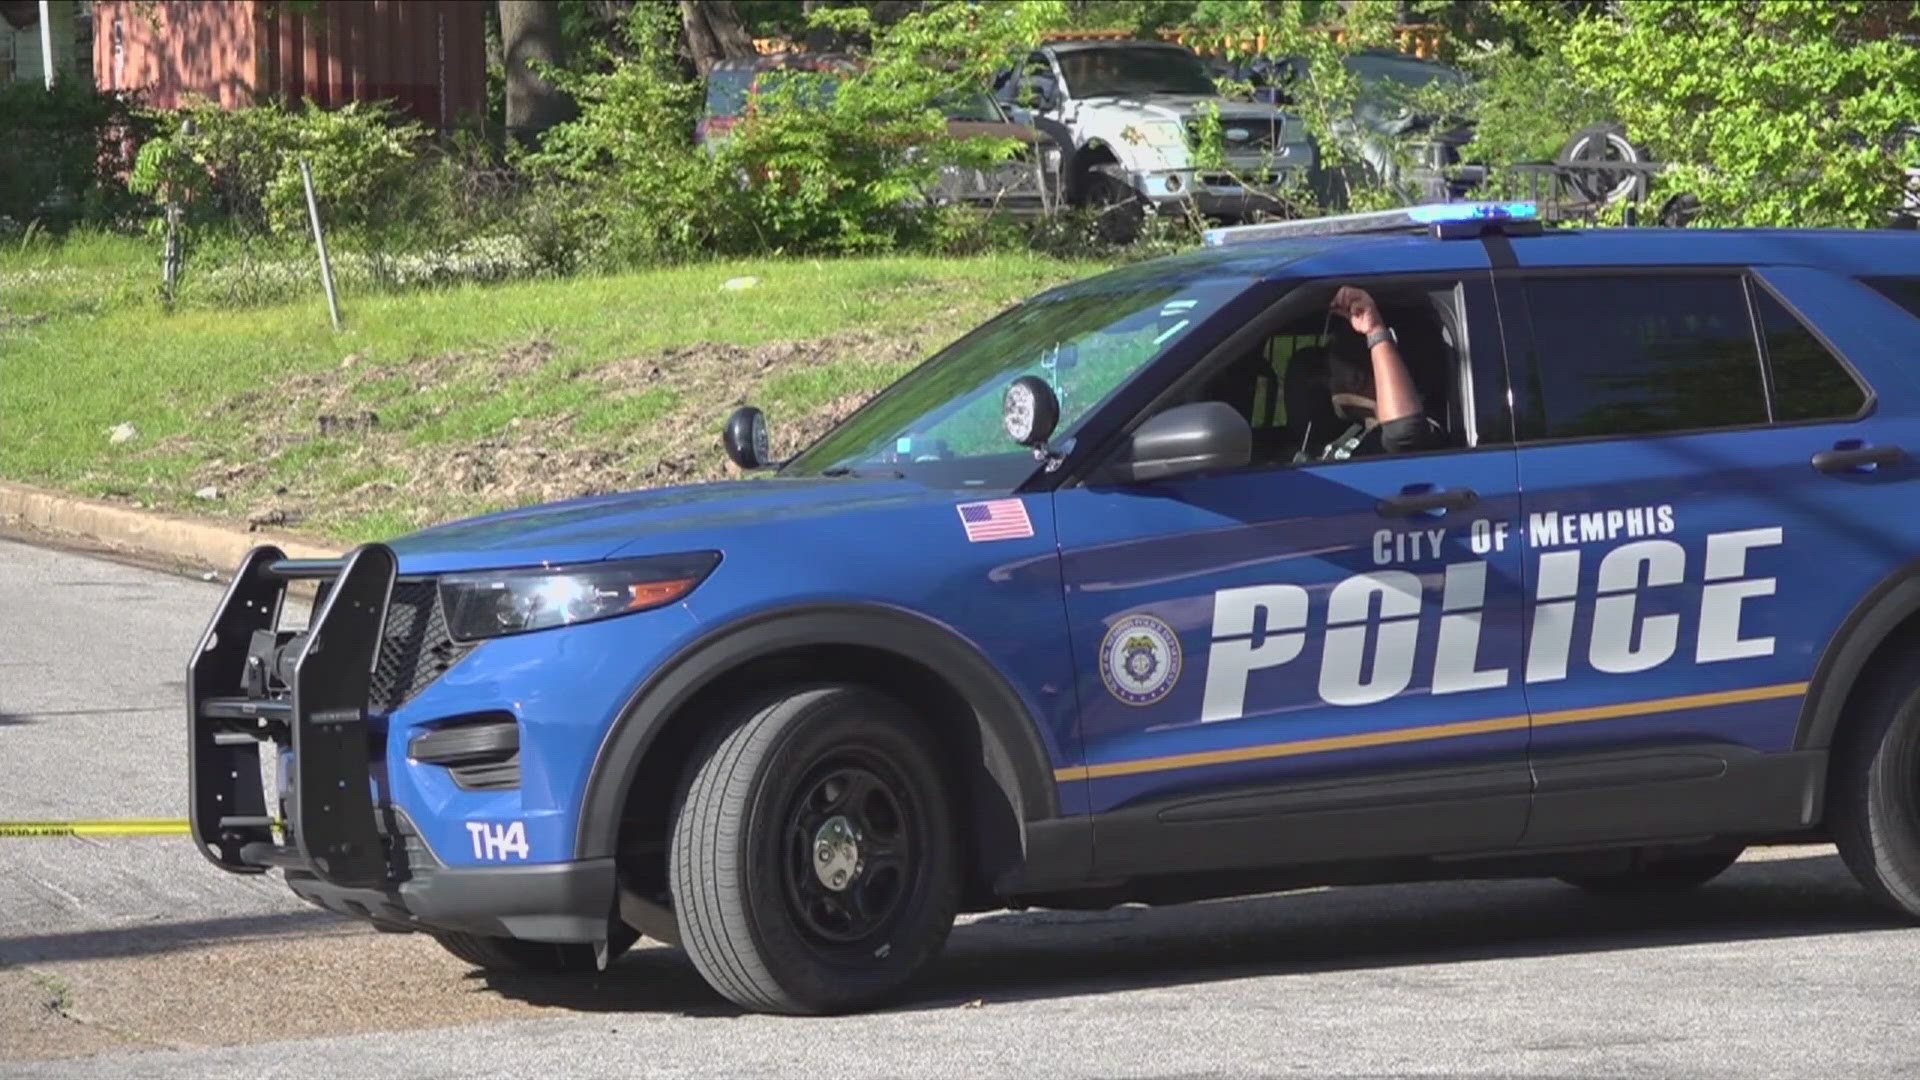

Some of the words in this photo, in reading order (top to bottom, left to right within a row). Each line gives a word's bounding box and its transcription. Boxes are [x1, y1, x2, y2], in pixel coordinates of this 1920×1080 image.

[1372, 528, 1446, 565] CITY
[1471, 518, 1509, 555] OF
[1530, 504, 1675, 548] MEMPHIS
[1201, 526, 1783, 723] POLICE
[465, 821, 529, 861] TH4
